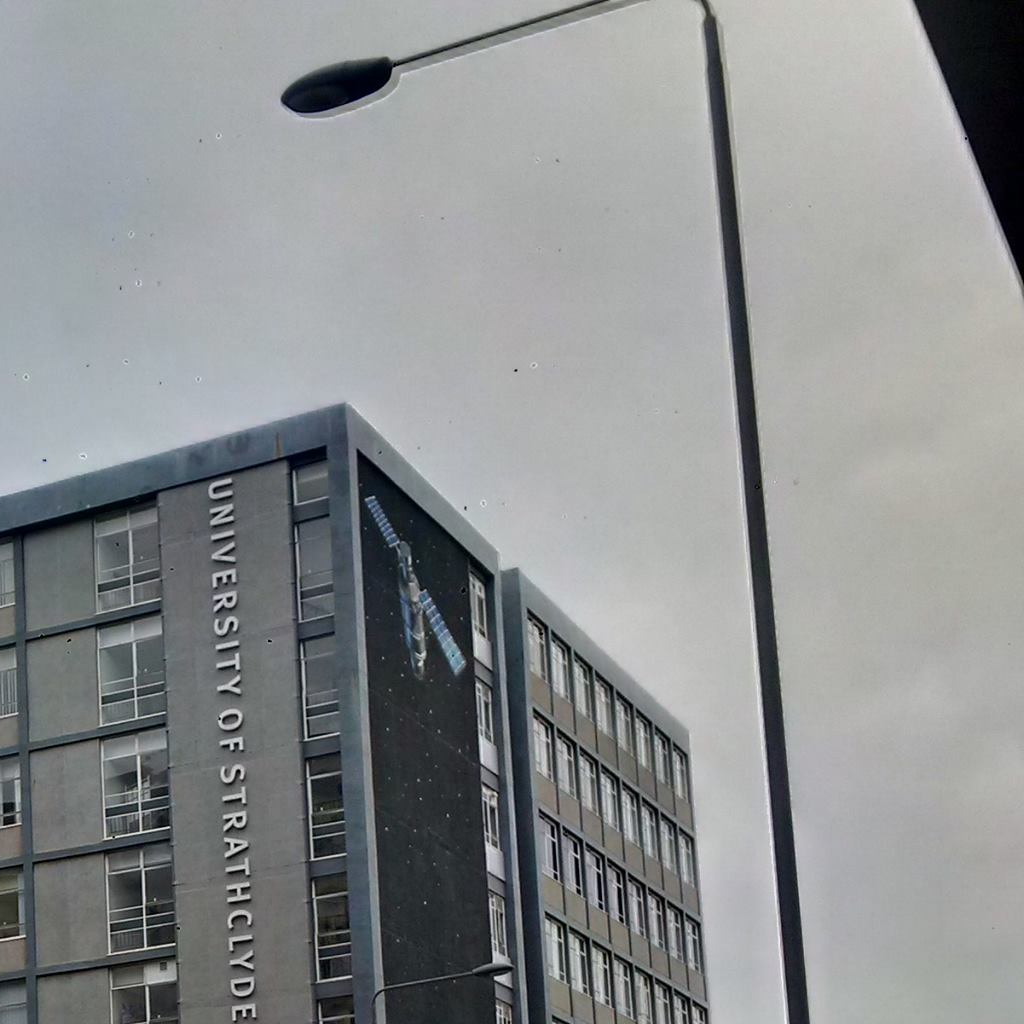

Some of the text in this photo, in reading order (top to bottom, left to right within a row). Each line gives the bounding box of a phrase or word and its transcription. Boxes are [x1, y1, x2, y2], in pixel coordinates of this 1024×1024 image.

[208, 477, 257, 1023] UNIVERSITY OF STRATHCLYDE
